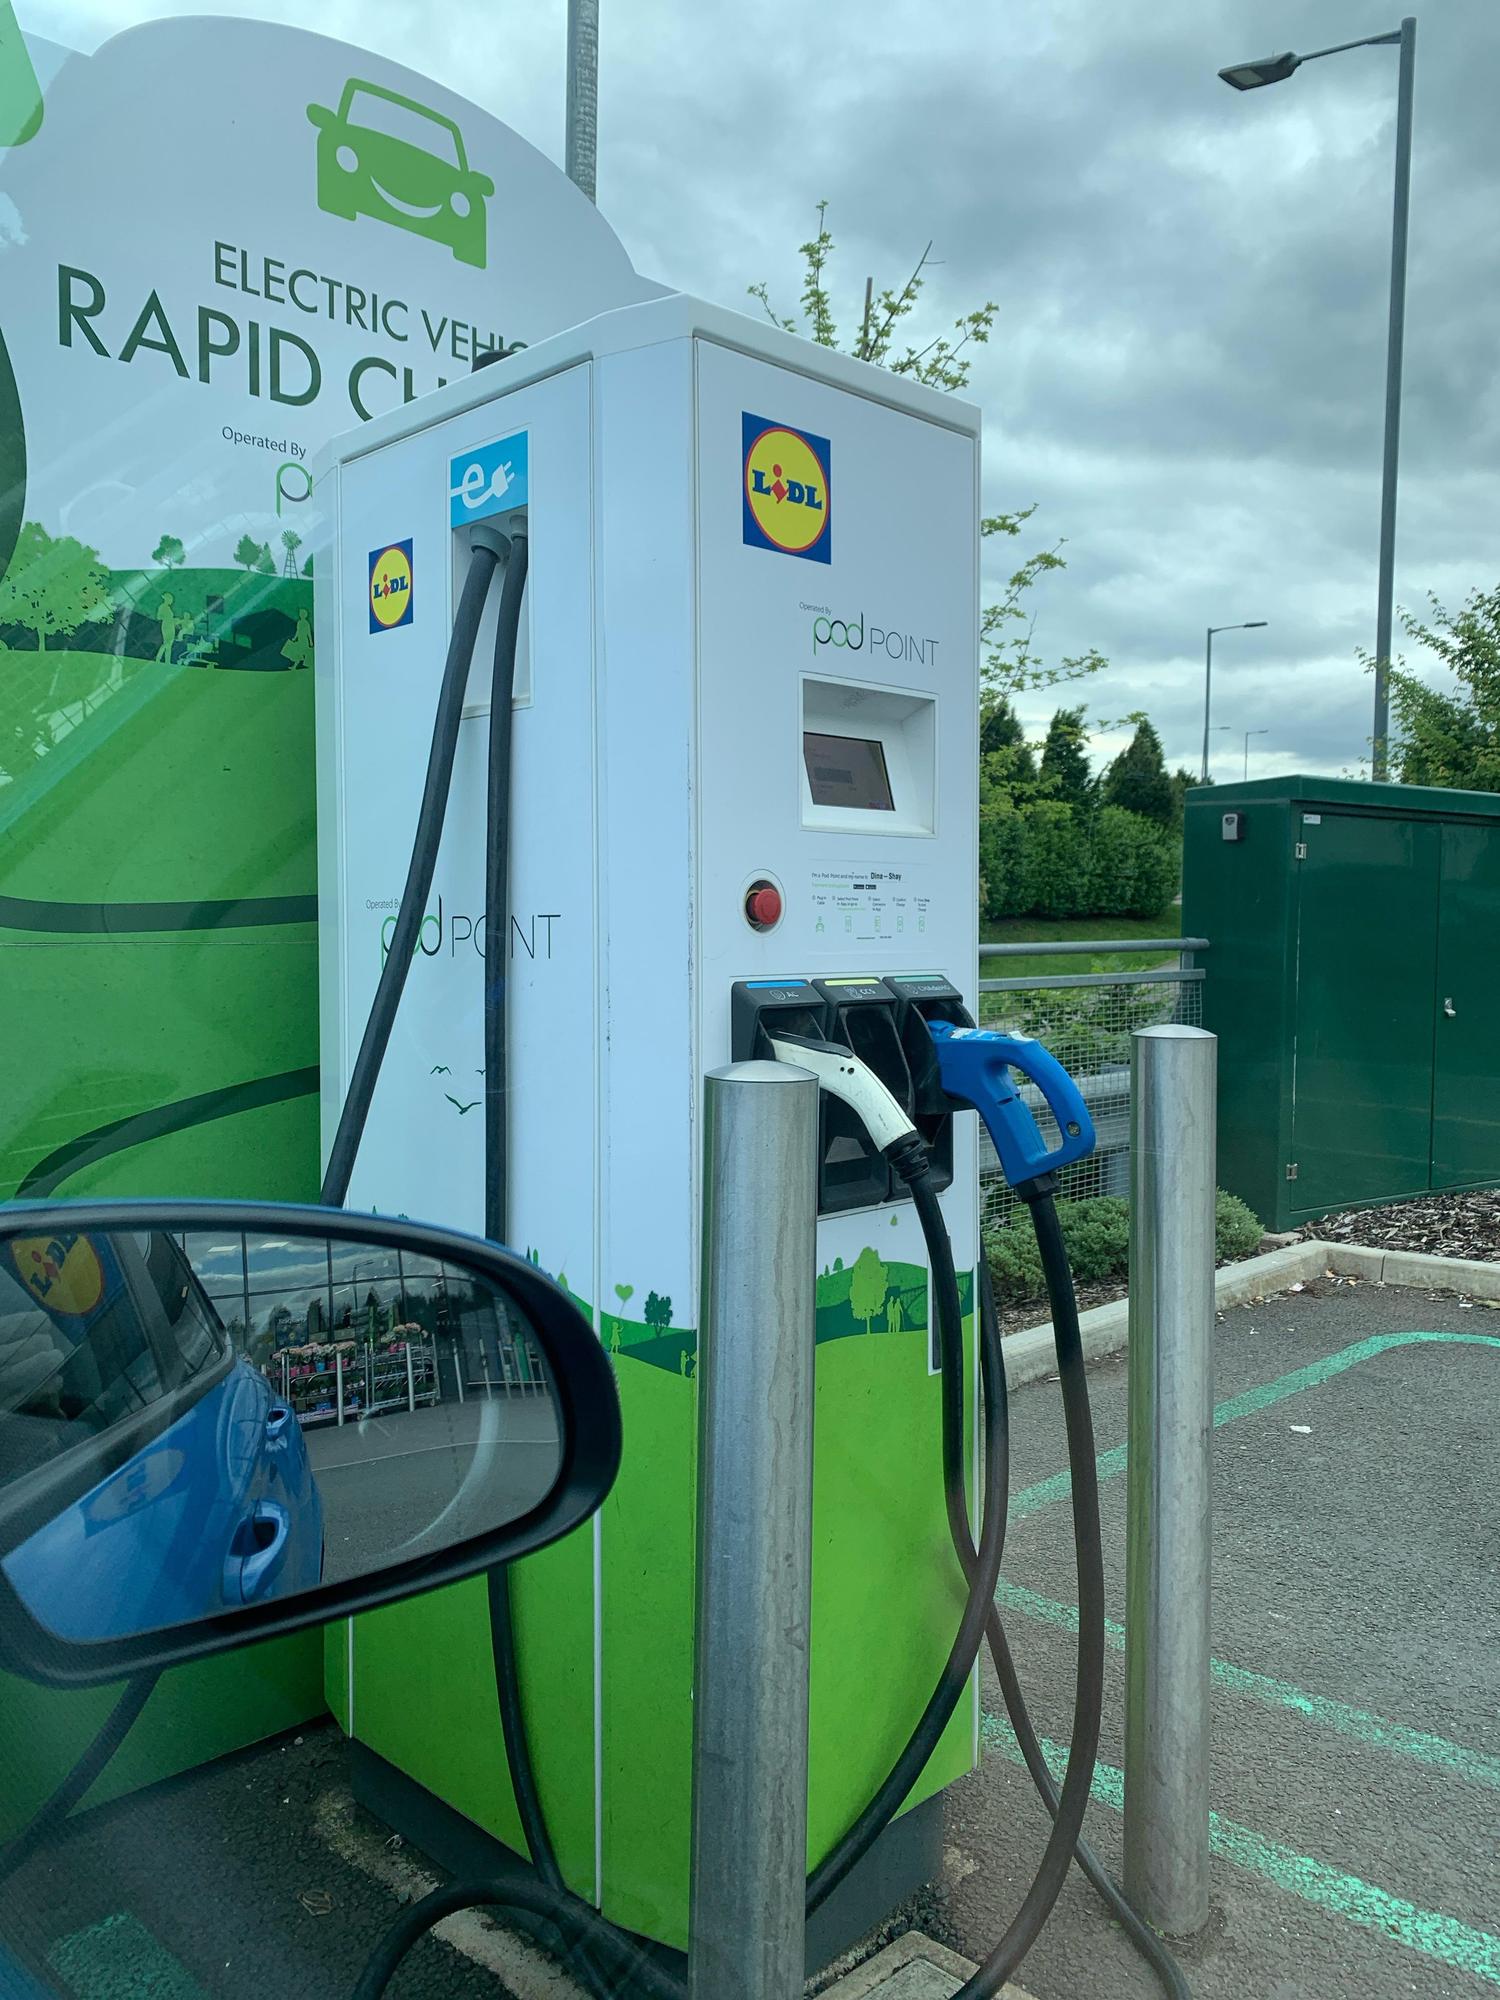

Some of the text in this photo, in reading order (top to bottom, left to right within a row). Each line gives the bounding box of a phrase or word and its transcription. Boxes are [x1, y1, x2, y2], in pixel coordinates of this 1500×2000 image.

[214, 240, 409, 342] ELECTRIC
[57, 263, 322, 407] RAPID
[221, 425, 307, 461] Operated By
[799, 601, 832, 616] Operated By
[813, 611, 940, 666] pod POINT
[366, 898, 393, 909] Operated
[381, 893, 442, 971] pd
